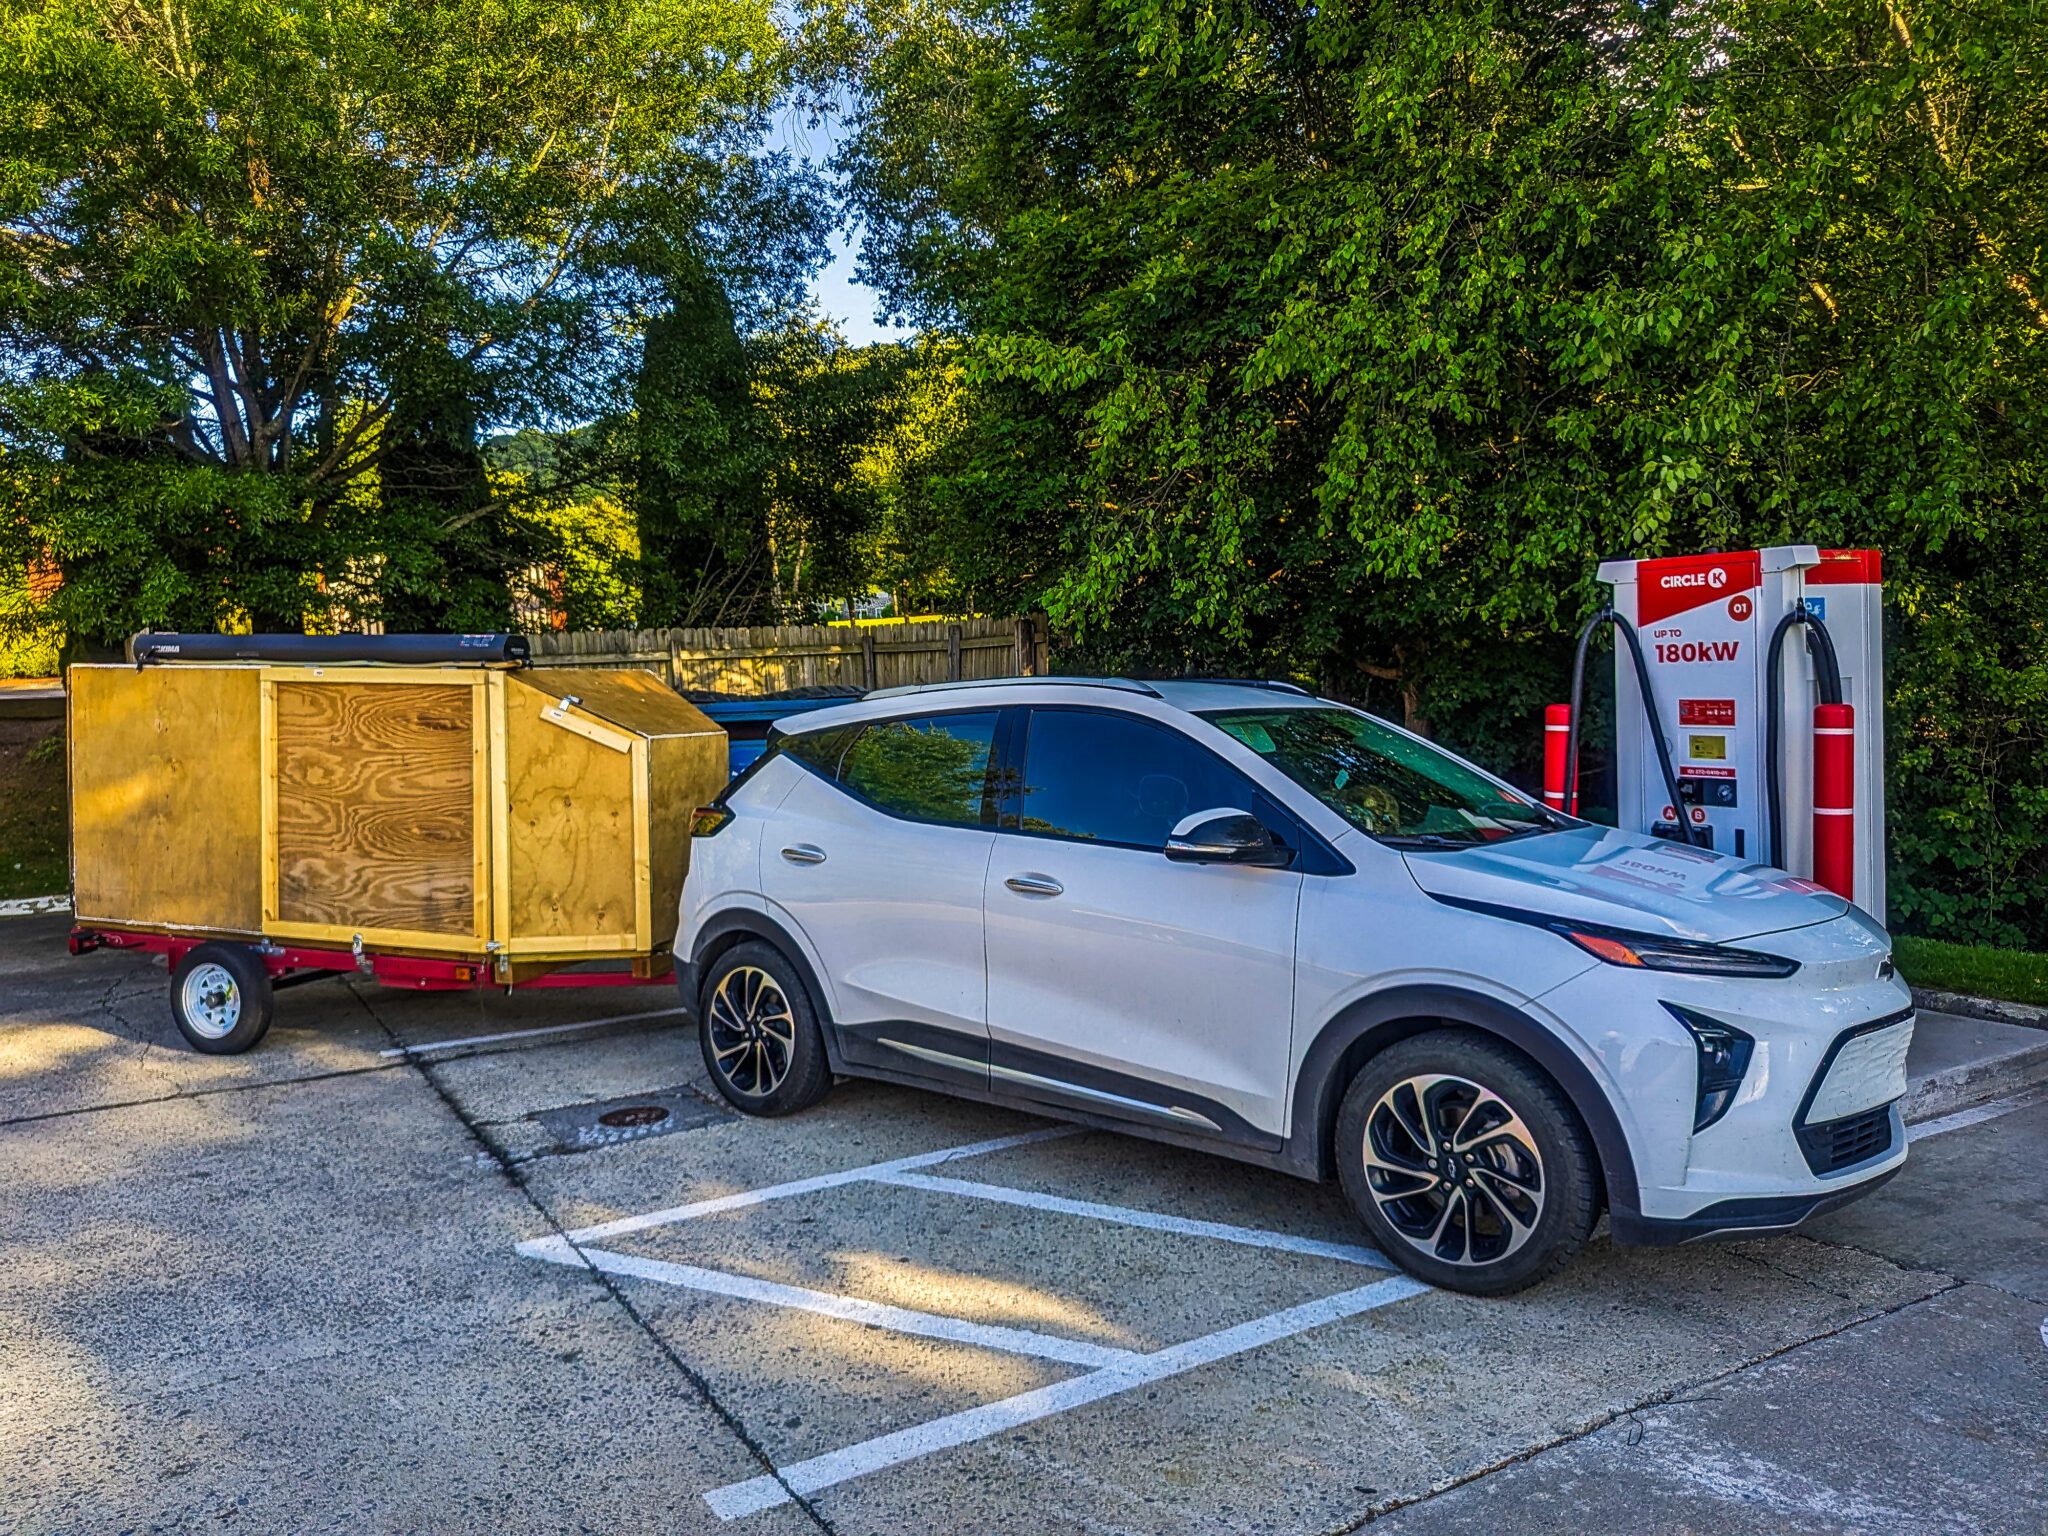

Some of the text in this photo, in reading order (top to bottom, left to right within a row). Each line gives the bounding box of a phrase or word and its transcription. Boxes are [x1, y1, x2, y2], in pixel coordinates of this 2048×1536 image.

[1661, 573, 1706, 588] CIRCLE
[1733, 603, 1747, 613] 01
[1654, 629, 1682, 638] UP TO
[151, 645, 180, 653] KIMA
[1655, 641, 1739, 663] 180kW
[1665, 809, 1674, 818] A
[1694, 811, 1702, 819] B
